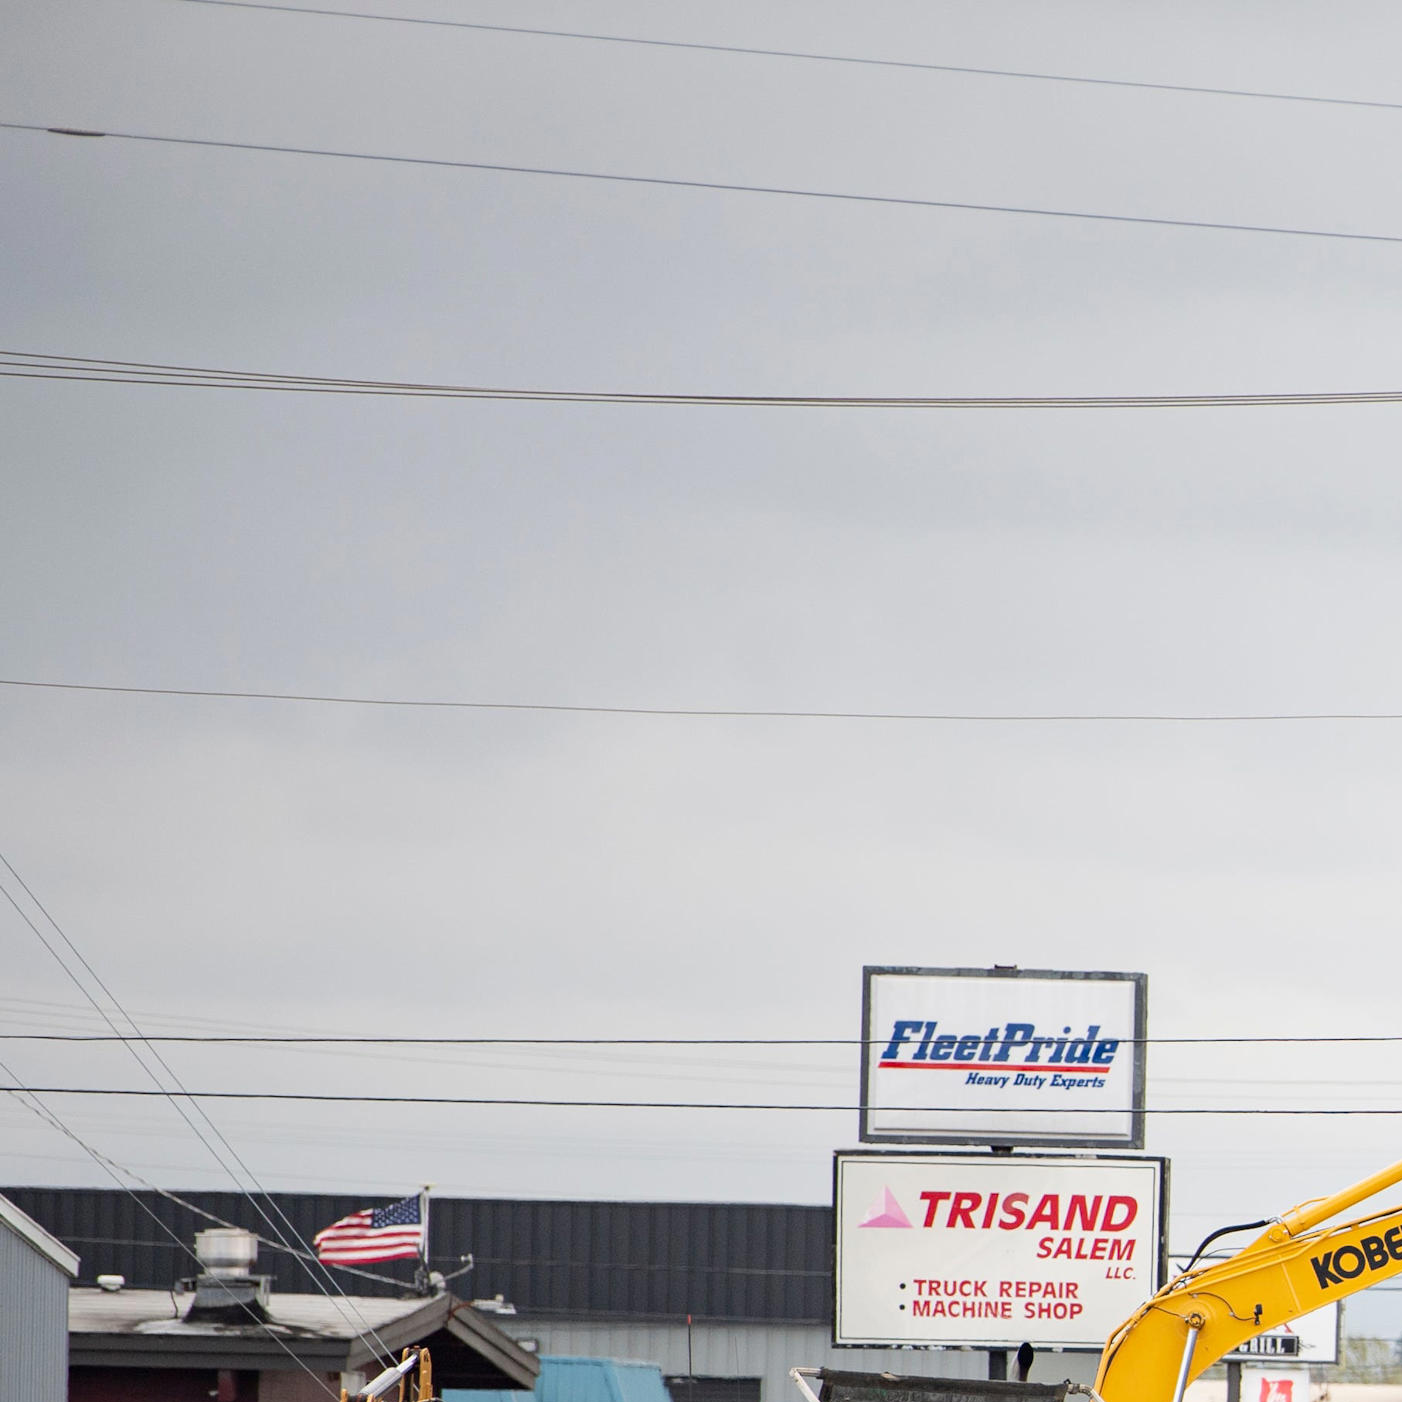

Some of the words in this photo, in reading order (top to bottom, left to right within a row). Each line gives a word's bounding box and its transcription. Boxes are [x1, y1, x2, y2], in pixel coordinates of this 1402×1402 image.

[880, 1020, 1119, 1065] FleetPride
[965, 1072, 1010, 1089] Heavy
[1013, 1073, 1046, 1090] Duty
[1050, 1074, 1105, 1090] Experts
[919, 1190, 1138, 1233] TRISAND
[1036, 1237, 1136, 1261] SALEM
[913, 1279, 988, 1298] TRUCK
[999, 1281, 1079, 1299] REPAIR
[912, 1299, 1013, 1319] MACHINE
[1024, 1302, 1083, 1320] SHOP
